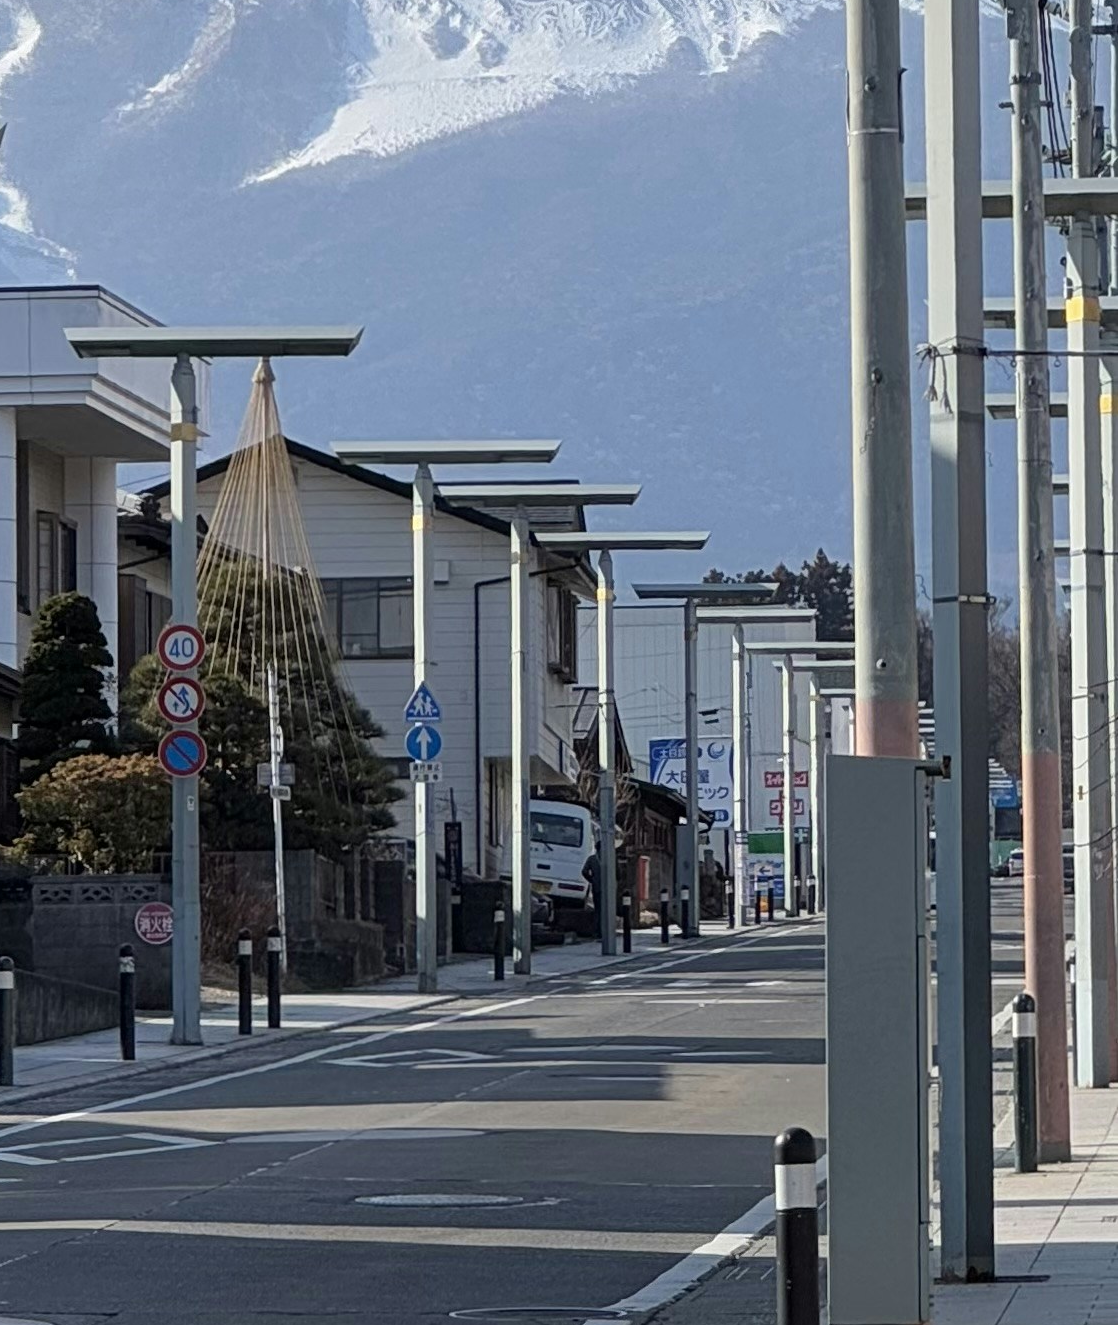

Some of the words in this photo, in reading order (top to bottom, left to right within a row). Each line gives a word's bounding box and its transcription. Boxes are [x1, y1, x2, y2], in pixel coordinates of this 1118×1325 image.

[168, 637, 195, 659] 40
[139, 915, 174, 933] 消火栓
